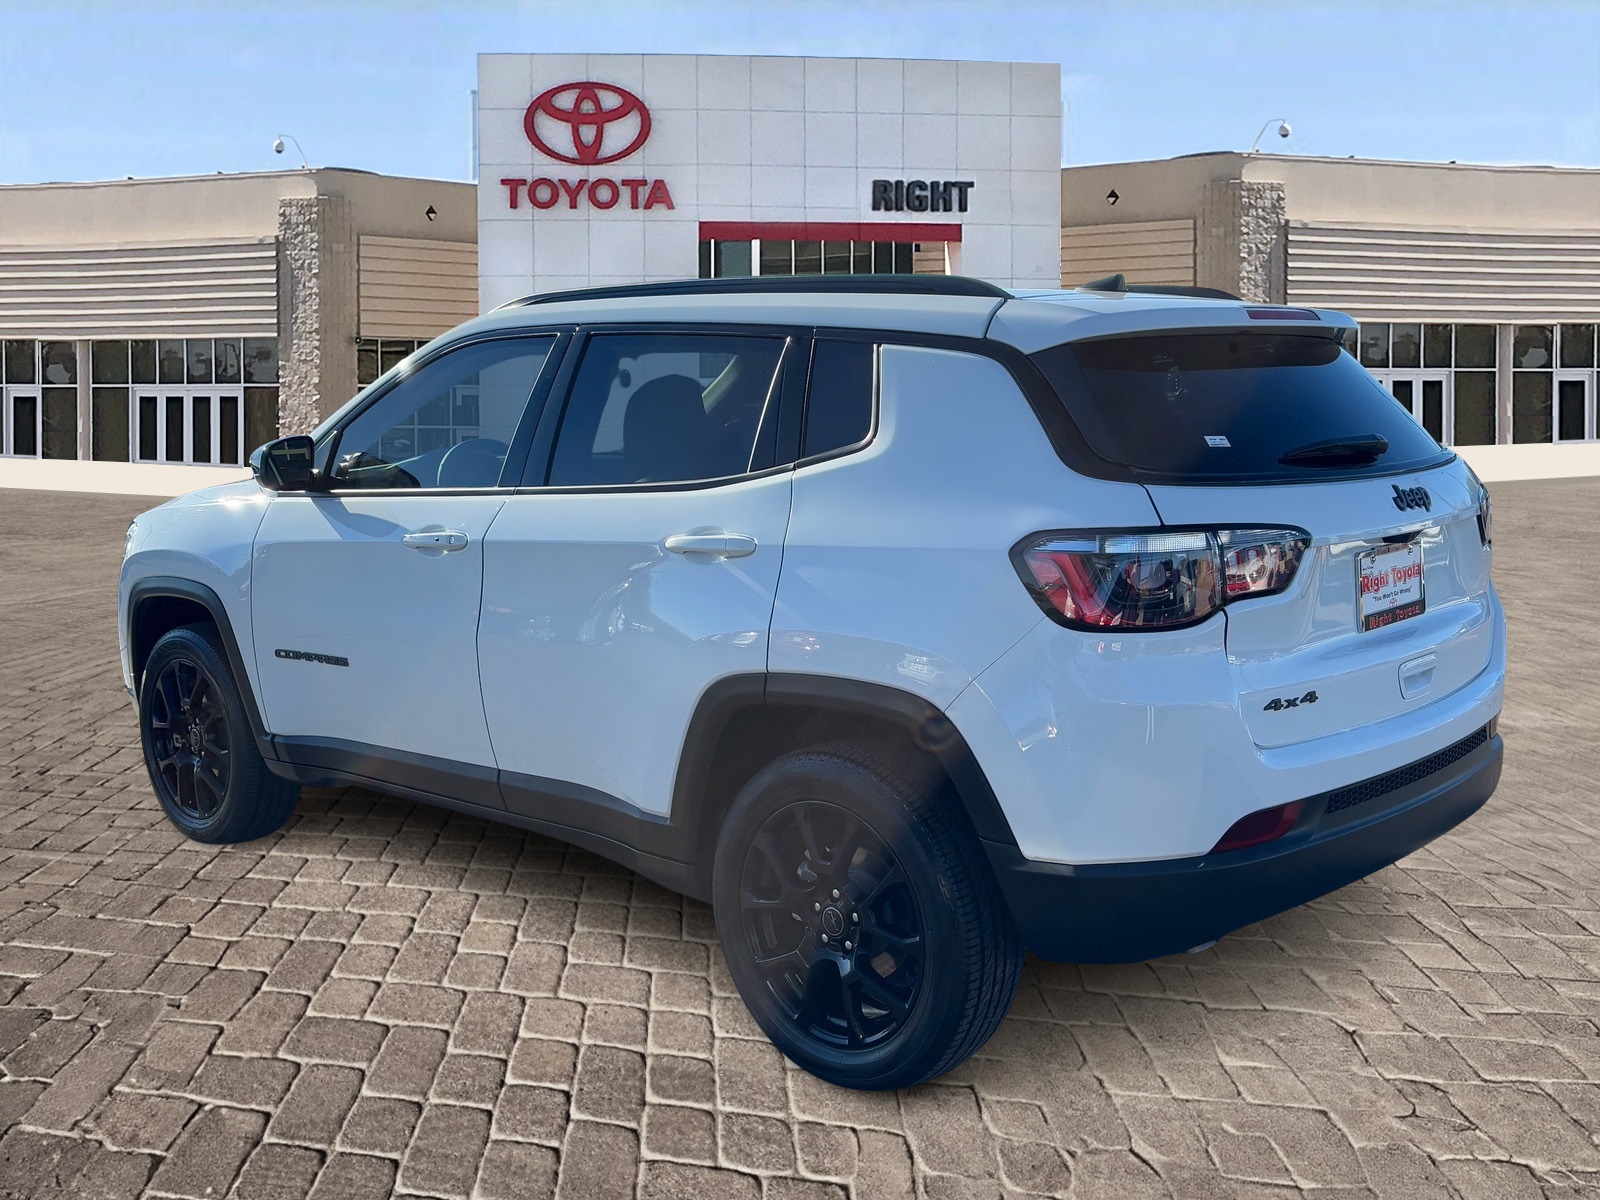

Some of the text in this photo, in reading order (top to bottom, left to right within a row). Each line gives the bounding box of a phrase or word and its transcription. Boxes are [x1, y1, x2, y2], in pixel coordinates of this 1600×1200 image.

[500, 177, 675, 210] TOYOTA
[872, 179, 975, 212] RIGHT
[1391, 484, 1432, 513] Jeep
[1361, 561, 1421, 595] Right Toyota
[1369, 605, 1421, 629] Right Toyota
[274, 648, 349, 667] COMPASS
[1263, 690, 1319, 711] 4x4
